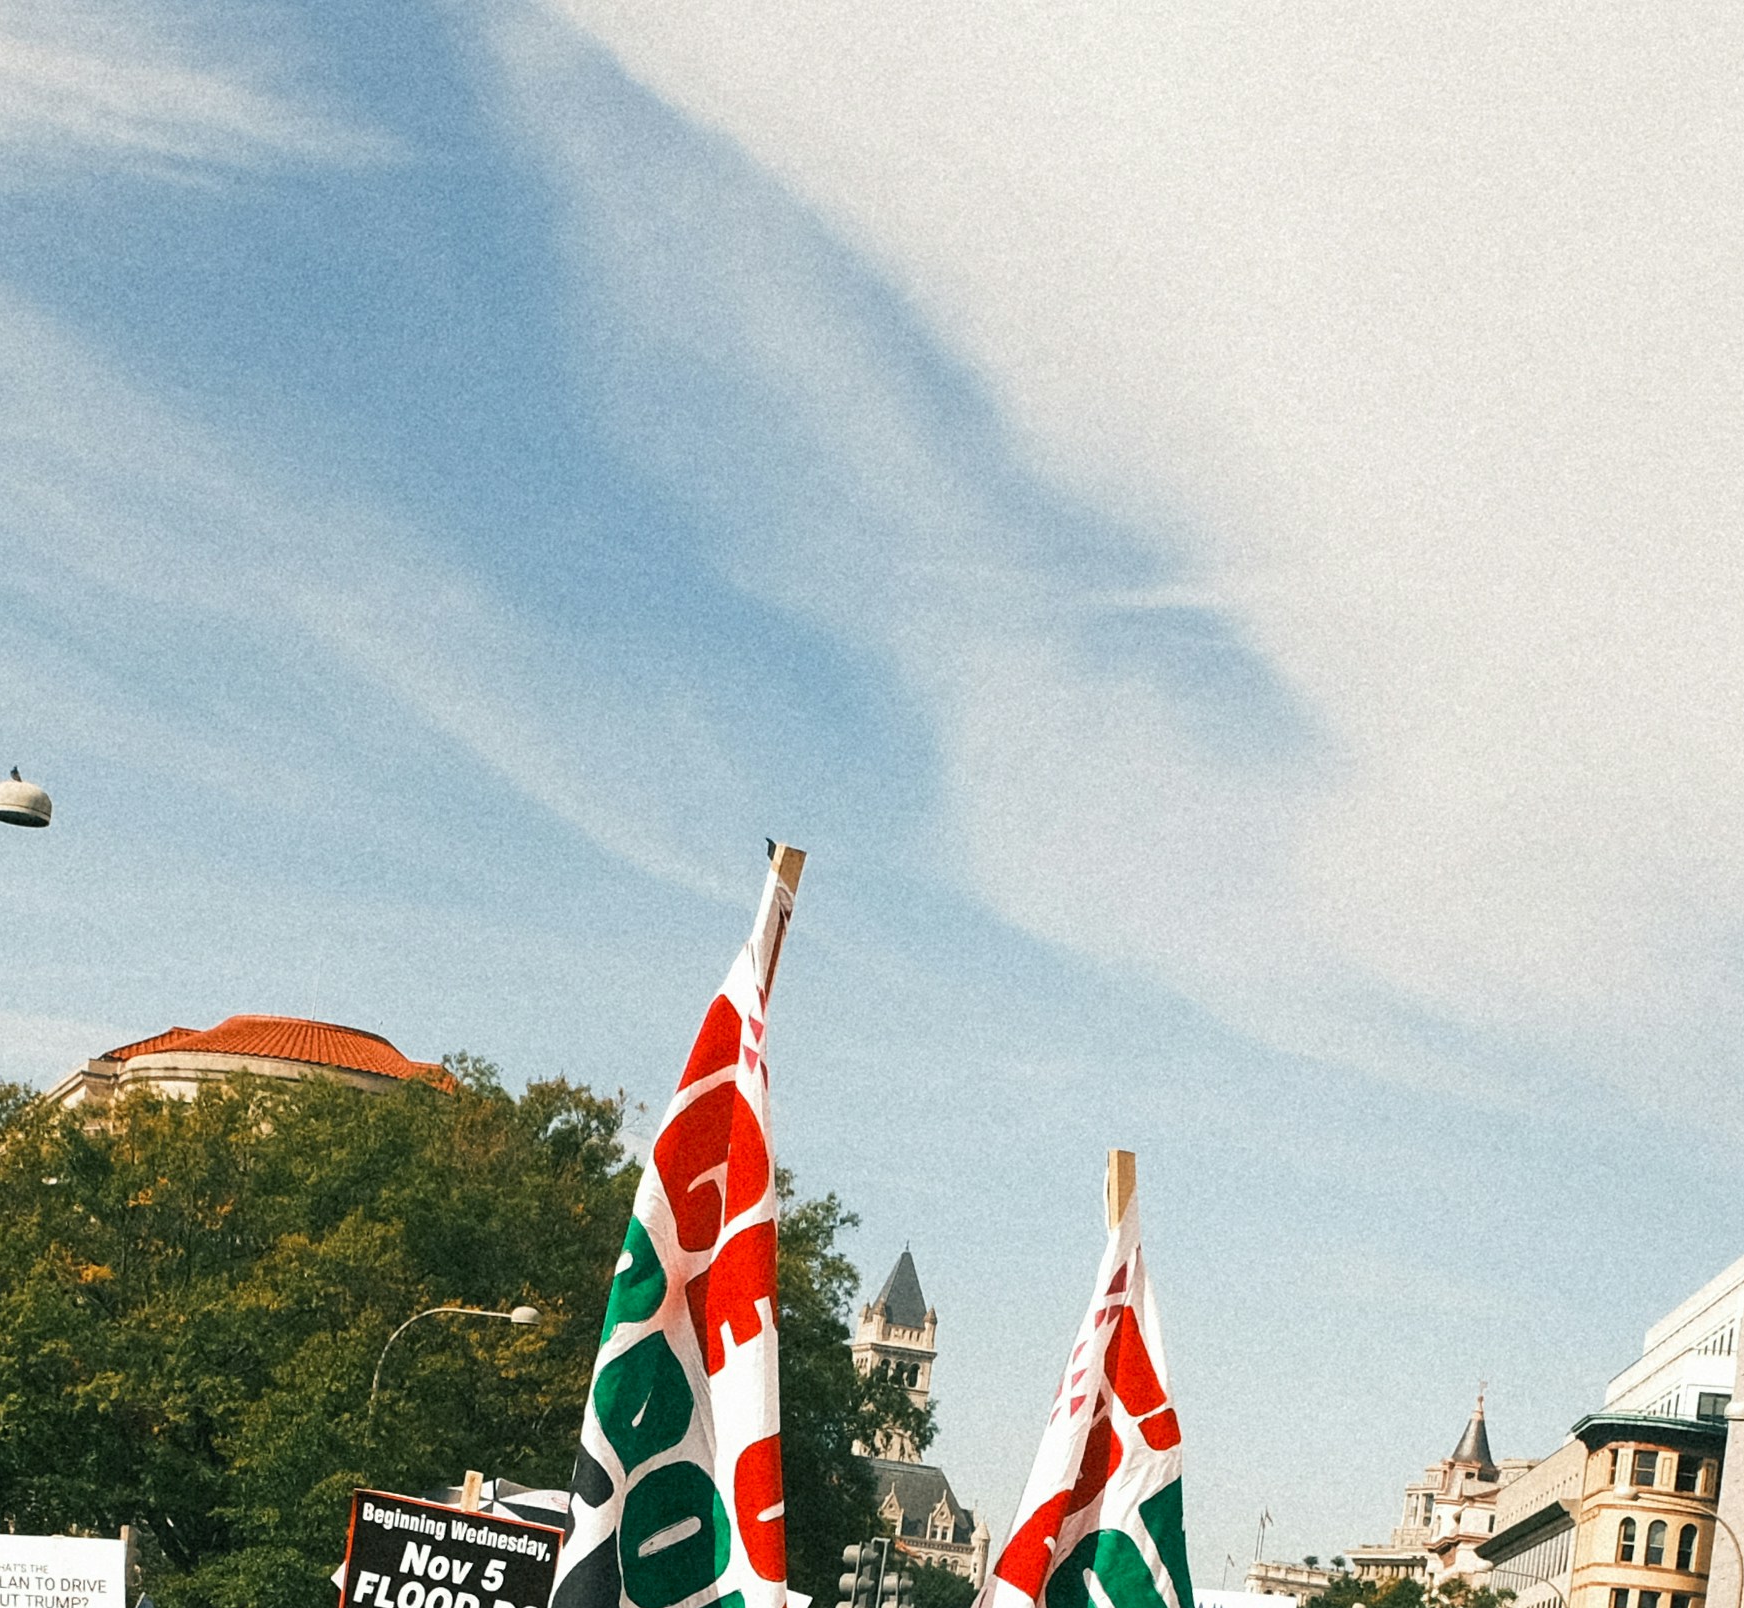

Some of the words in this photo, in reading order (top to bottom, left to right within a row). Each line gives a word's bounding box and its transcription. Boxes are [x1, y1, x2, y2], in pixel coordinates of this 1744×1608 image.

[362, 1501, 446, 1541] Beginning
[451, 1519, 551, 1563] Wednesday,
[30, 1563, 49, 1574] THE
[399, 1541, 474, 1585] Nov
[480, 1558, 507, 1592] 5
[35, 1577, 56, 1591] TO
[60, 1578, 108, 1594] DRIVE
